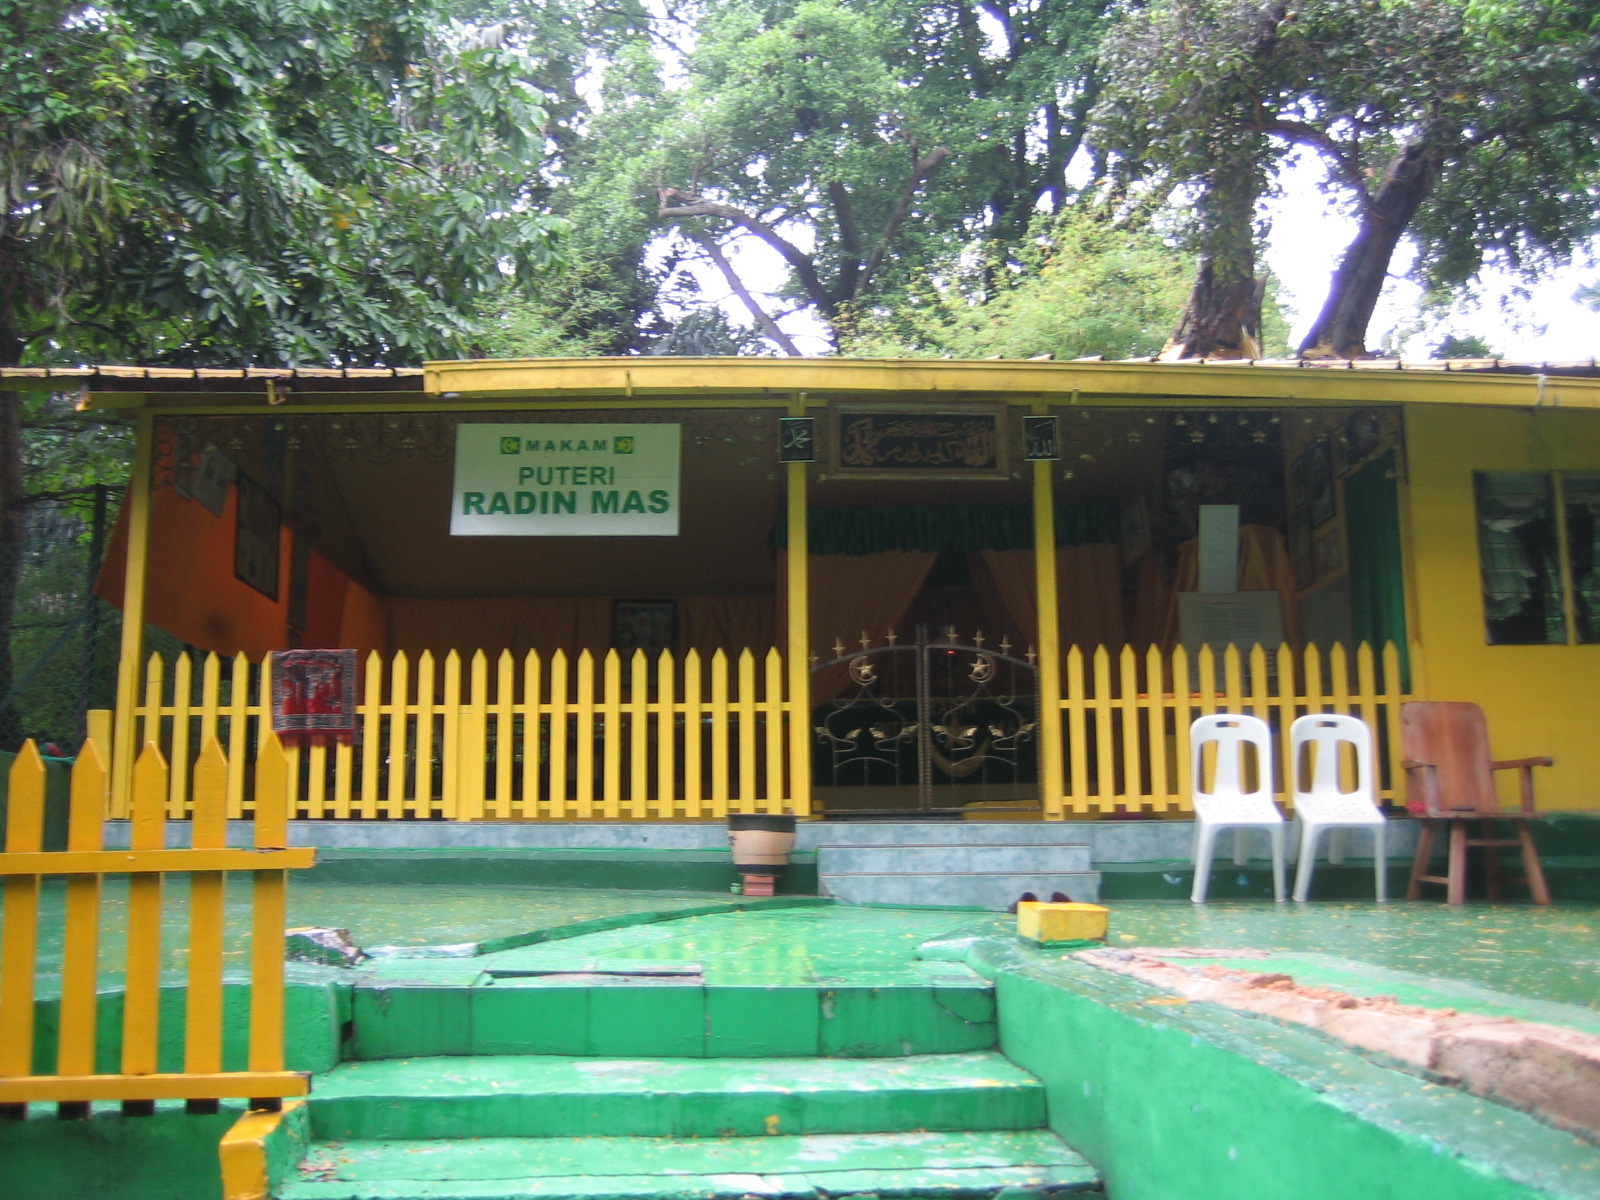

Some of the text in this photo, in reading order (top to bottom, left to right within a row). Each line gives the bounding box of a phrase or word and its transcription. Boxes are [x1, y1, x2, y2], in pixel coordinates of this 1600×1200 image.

[526, 439, 608, 452] MAKAM
[518, 466, 616, 486] PUTERI
[462, 489, 670, 516] RADIN MAS
